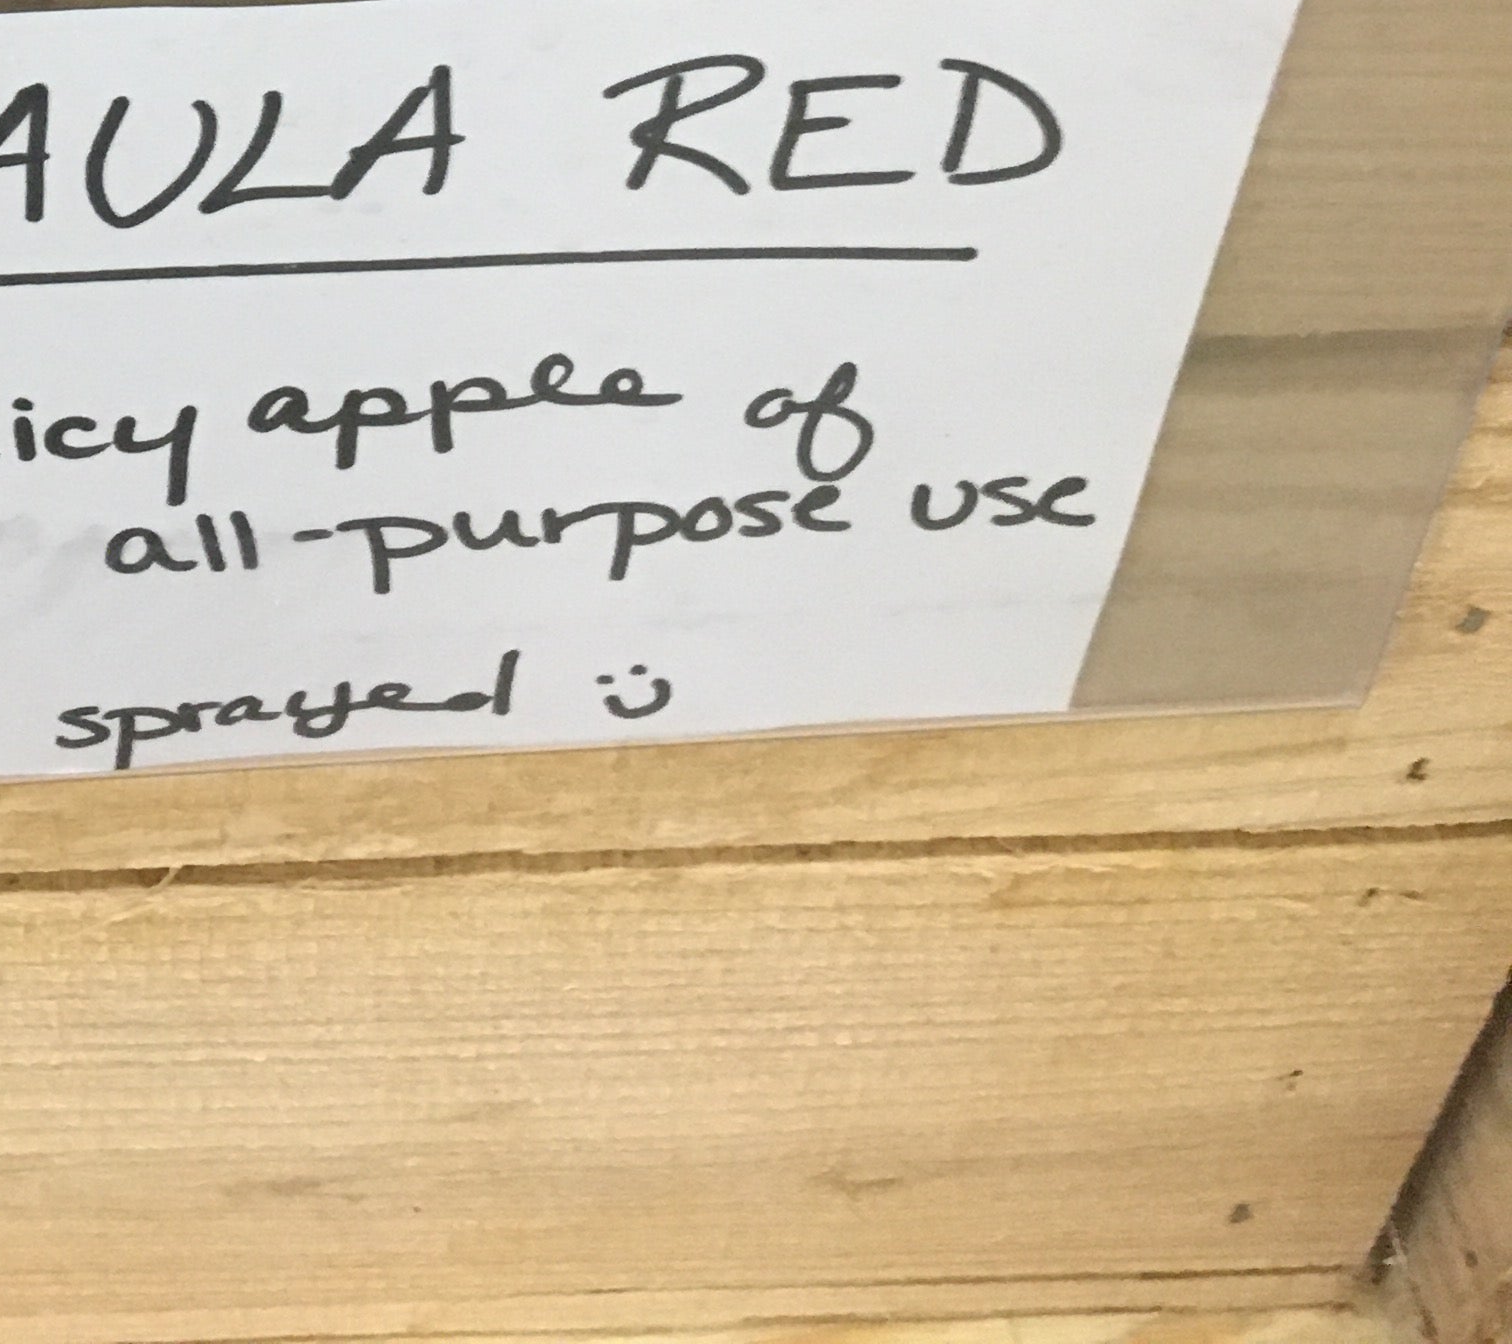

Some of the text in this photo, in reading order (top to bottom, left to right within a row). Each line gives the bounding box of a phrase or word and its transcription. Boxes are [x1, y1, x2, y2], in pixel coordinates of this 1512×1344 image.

[603, 54, 1062, 196] RED
[248, 352, 683, 471] apple
[744, 360, 875, 483] of
[104, 483, 852, 596] all-purpose
[910, 475, 1096, 532] use
[55, 648, 521, 771] sprayed
